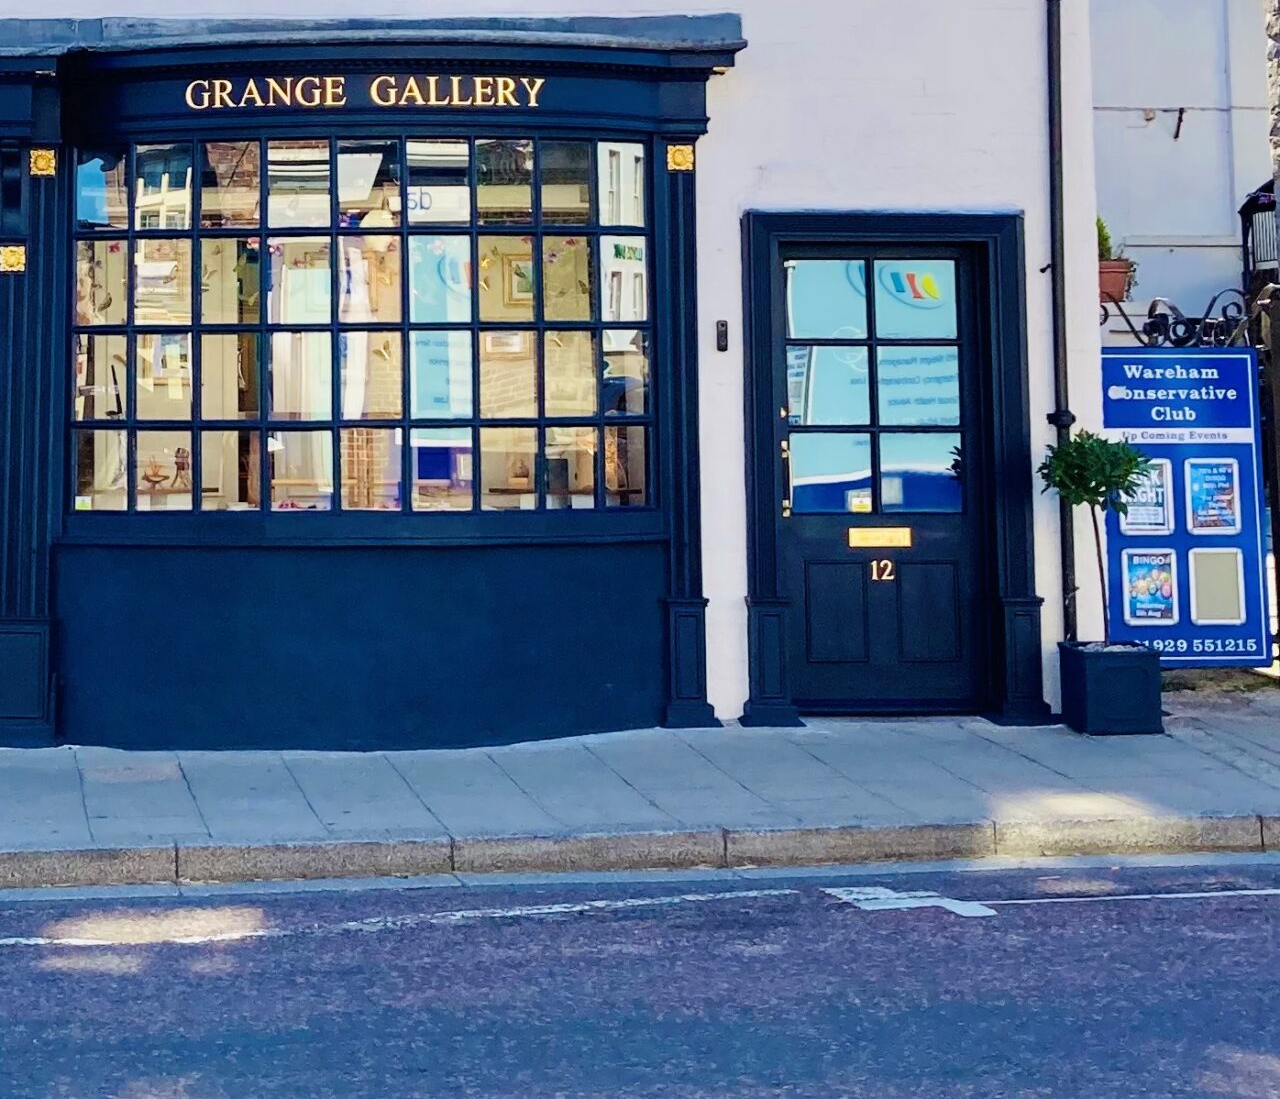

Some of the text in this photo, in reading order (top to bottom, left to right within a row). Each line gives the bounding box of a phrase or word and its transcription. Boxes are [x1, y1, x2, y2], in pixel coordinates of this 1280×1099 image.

[185, 75, 546, 110] GRANGE GALLERY
[1123, 365, 1219, 379] Wareham
[1151, 406, 1197, 421] Club
[1141, 431, 1186, 441] Coming
[1189, 431, 1228, 440] Events
[1133, 556, 1165, 565] BINGO
[870, 559, 895, 580] 12
[1134, 639, 1257, 652] 1929 551215
